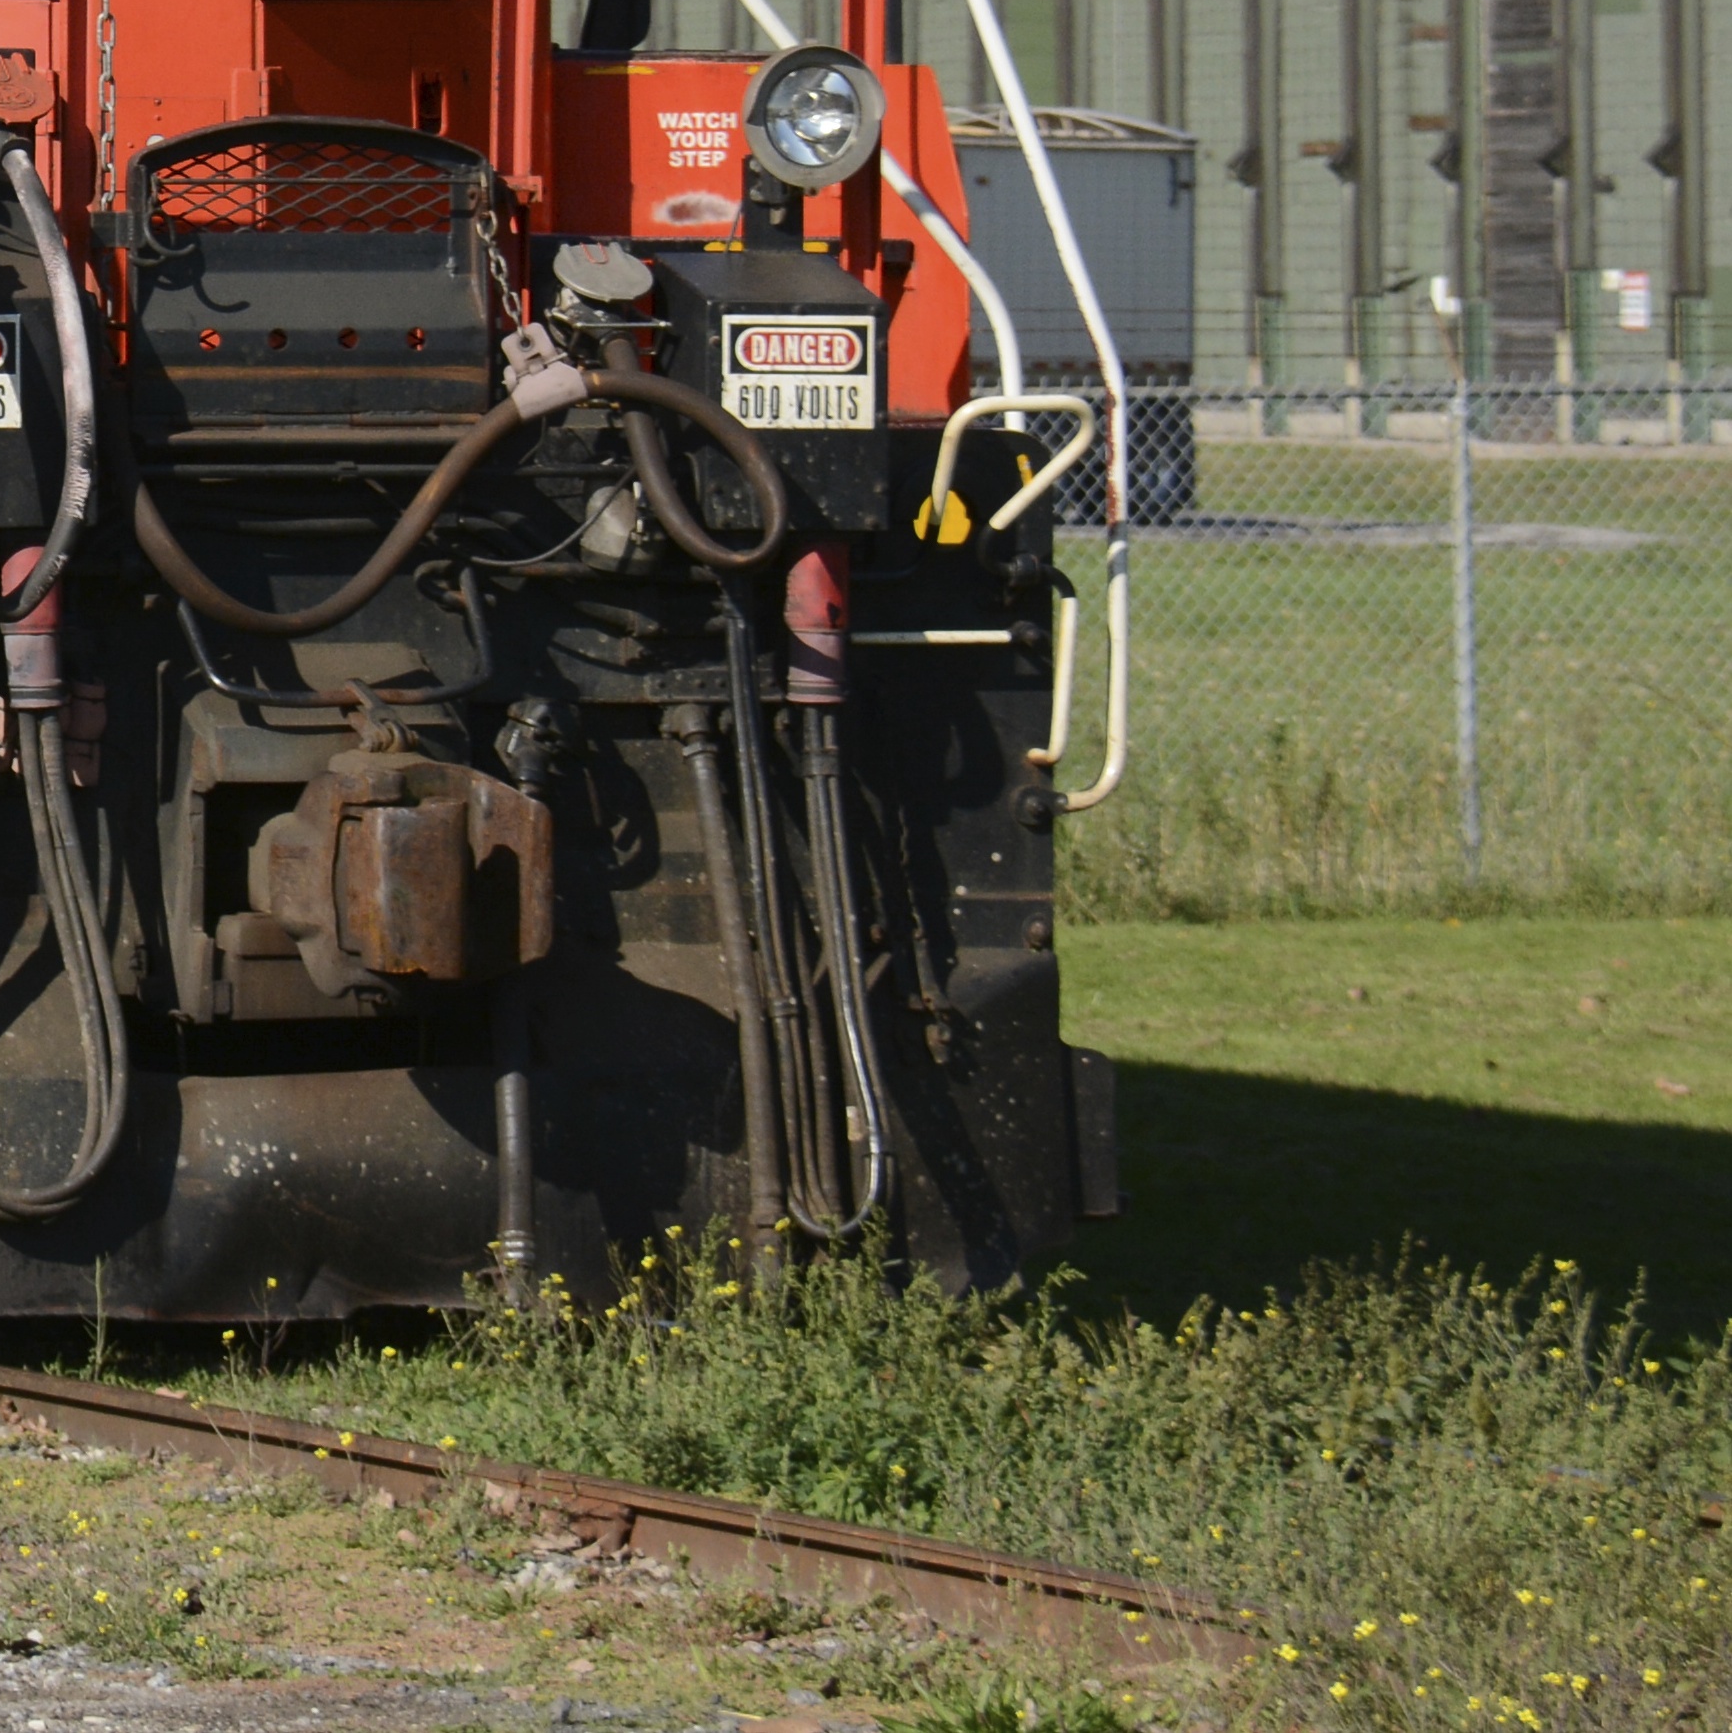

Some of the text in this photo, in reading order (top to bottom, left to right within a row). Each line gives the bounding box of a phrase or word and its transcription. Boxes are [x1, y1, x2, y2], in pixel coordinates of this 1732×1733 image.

[657, 112, 738, 129] WATCH
[665, 131, 730, 148] YOUR
[668, 150, 727, 168] STEP
[750, 334, 849, 364] DANGER
[739, 385, 858, 420] 600 VOLTS
